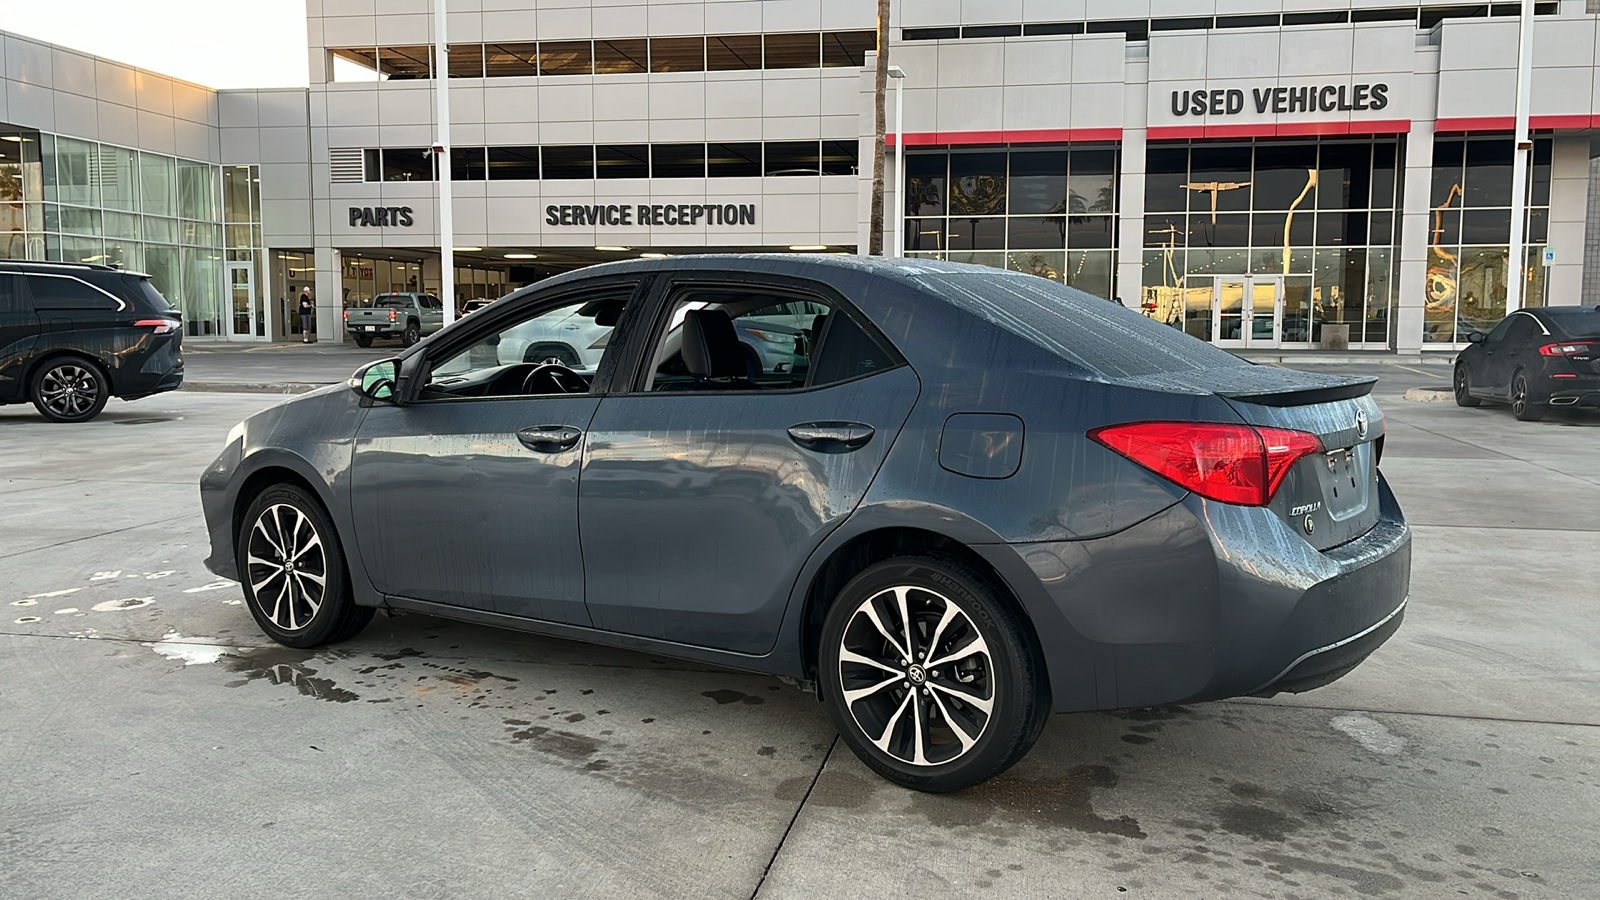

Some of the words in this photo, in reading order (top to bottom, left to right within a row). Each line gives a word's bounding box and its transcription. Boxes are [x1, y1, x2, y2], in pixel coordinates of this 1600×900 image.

[1171, 89, 1244, 116] USED
[1252, 83, 1389, 114] VEHICLES
[348, 206, 413, 227] PARTS
[545, 204, 632, 226] SERVICE
[637, 203, 756, 226] RECEPTION
[1289, 501, 1321, 516] COROLLA
